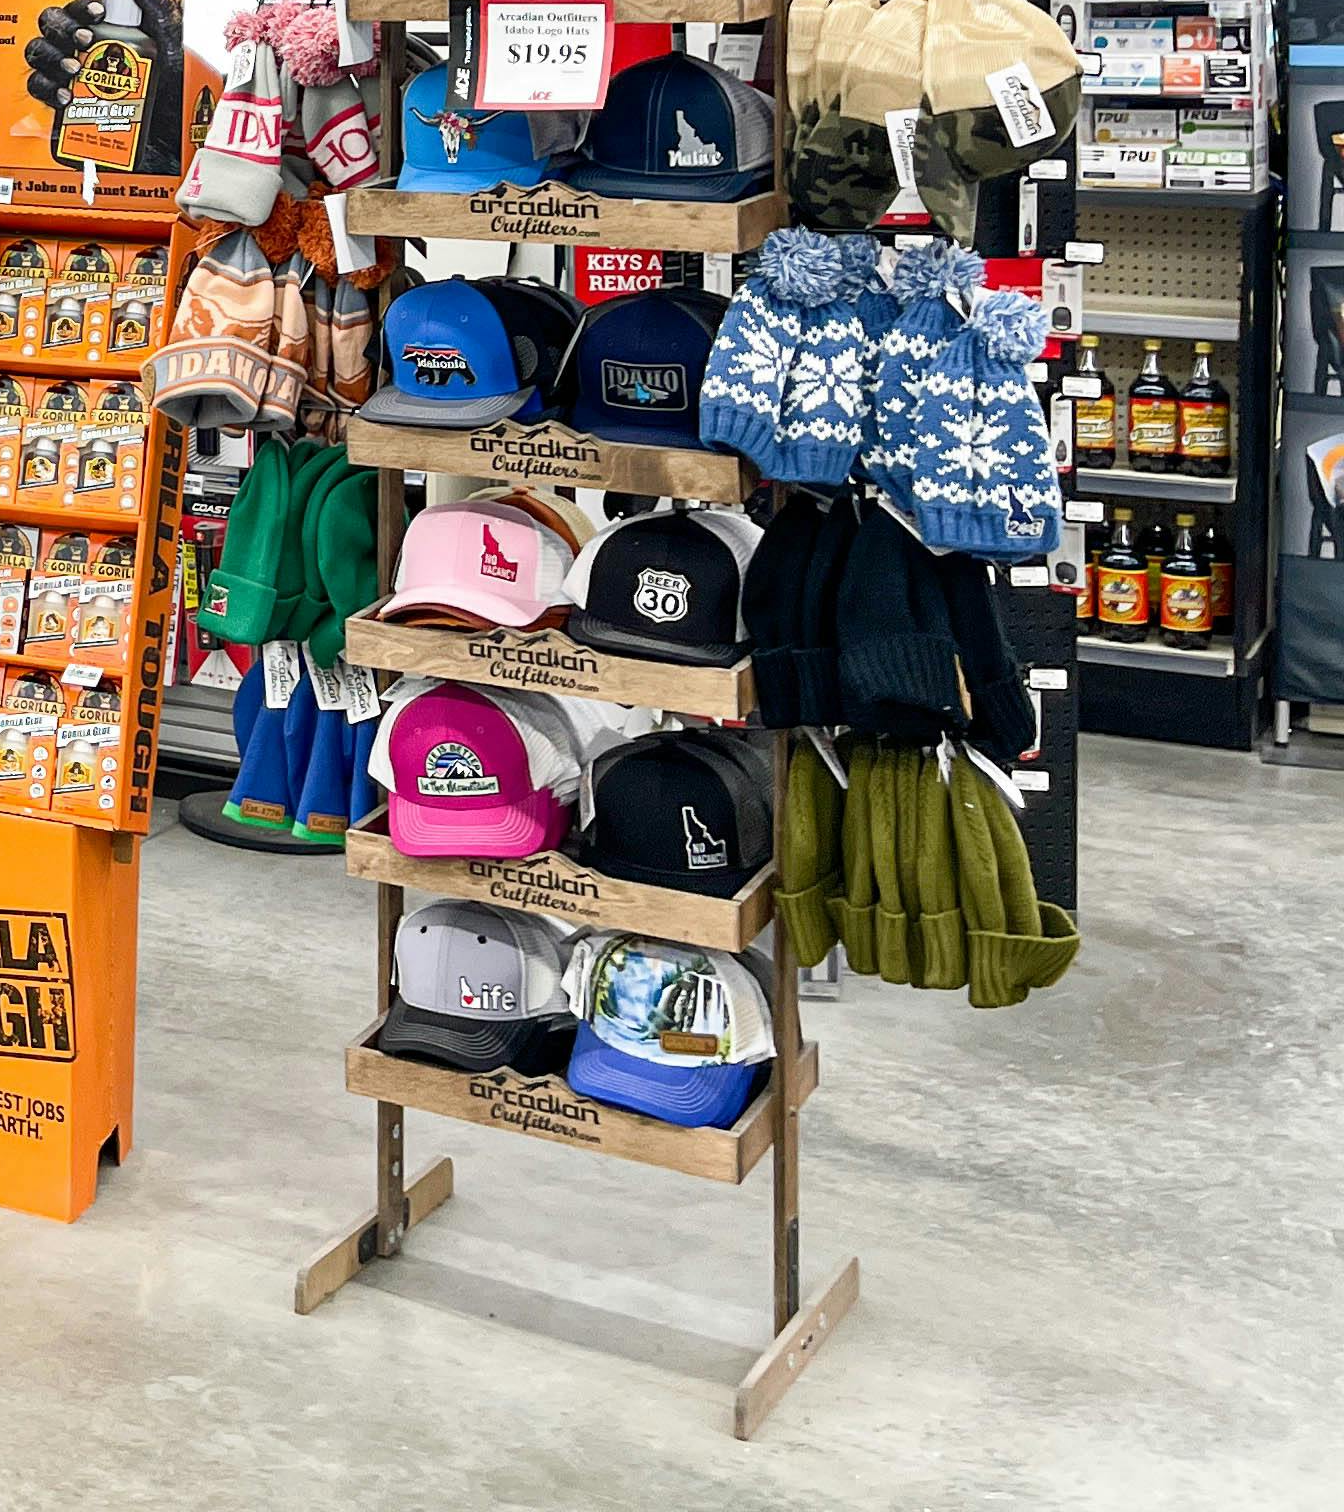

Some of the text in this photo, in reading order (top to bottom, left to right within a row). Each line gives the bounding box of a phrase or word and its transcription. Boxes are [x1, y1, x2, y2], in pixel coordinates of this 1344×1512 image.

[497, 12, 599, 24] Arcadian Outfitters
[504, 25, 590, 37] Idaho Logo Hats
[507, 43, 588, 66] $19.95
[85, 70, 132, 91] GORILLA
[454, 67, 471, 100] ACE
[528, 90, 553, 101] ACE
[109, 103, 136, 118] GLUE
[26, 180, 57, 194] Jobs
[59, 183, 77, 194] on
[129, 185, 170, 199] Earth
[470, 194, 600, 220] arcadian
[1, 267, 45, 280] GORILLA
[587, 254, 642, 272] KEYS
[66, 271, 110, 284] GORILLA
[607, 364, 679, 391] IDAHO
[98, 411, 144, 425] GORILLA
[470, 431, 601, 463] arcadian
[191, 502, 230, 515] COAST
[647, 576, 682, 589] BEER
[642, 588, 682, 616] 30
[469, 642, 599, 674] arcadian
[132, 614, 165, 814] TOUGH
[469, 861, 600, 899] arcadian
[25, 1098, 65, 1123] JOBS
[469, 1081, 601, 1125] arcadian
